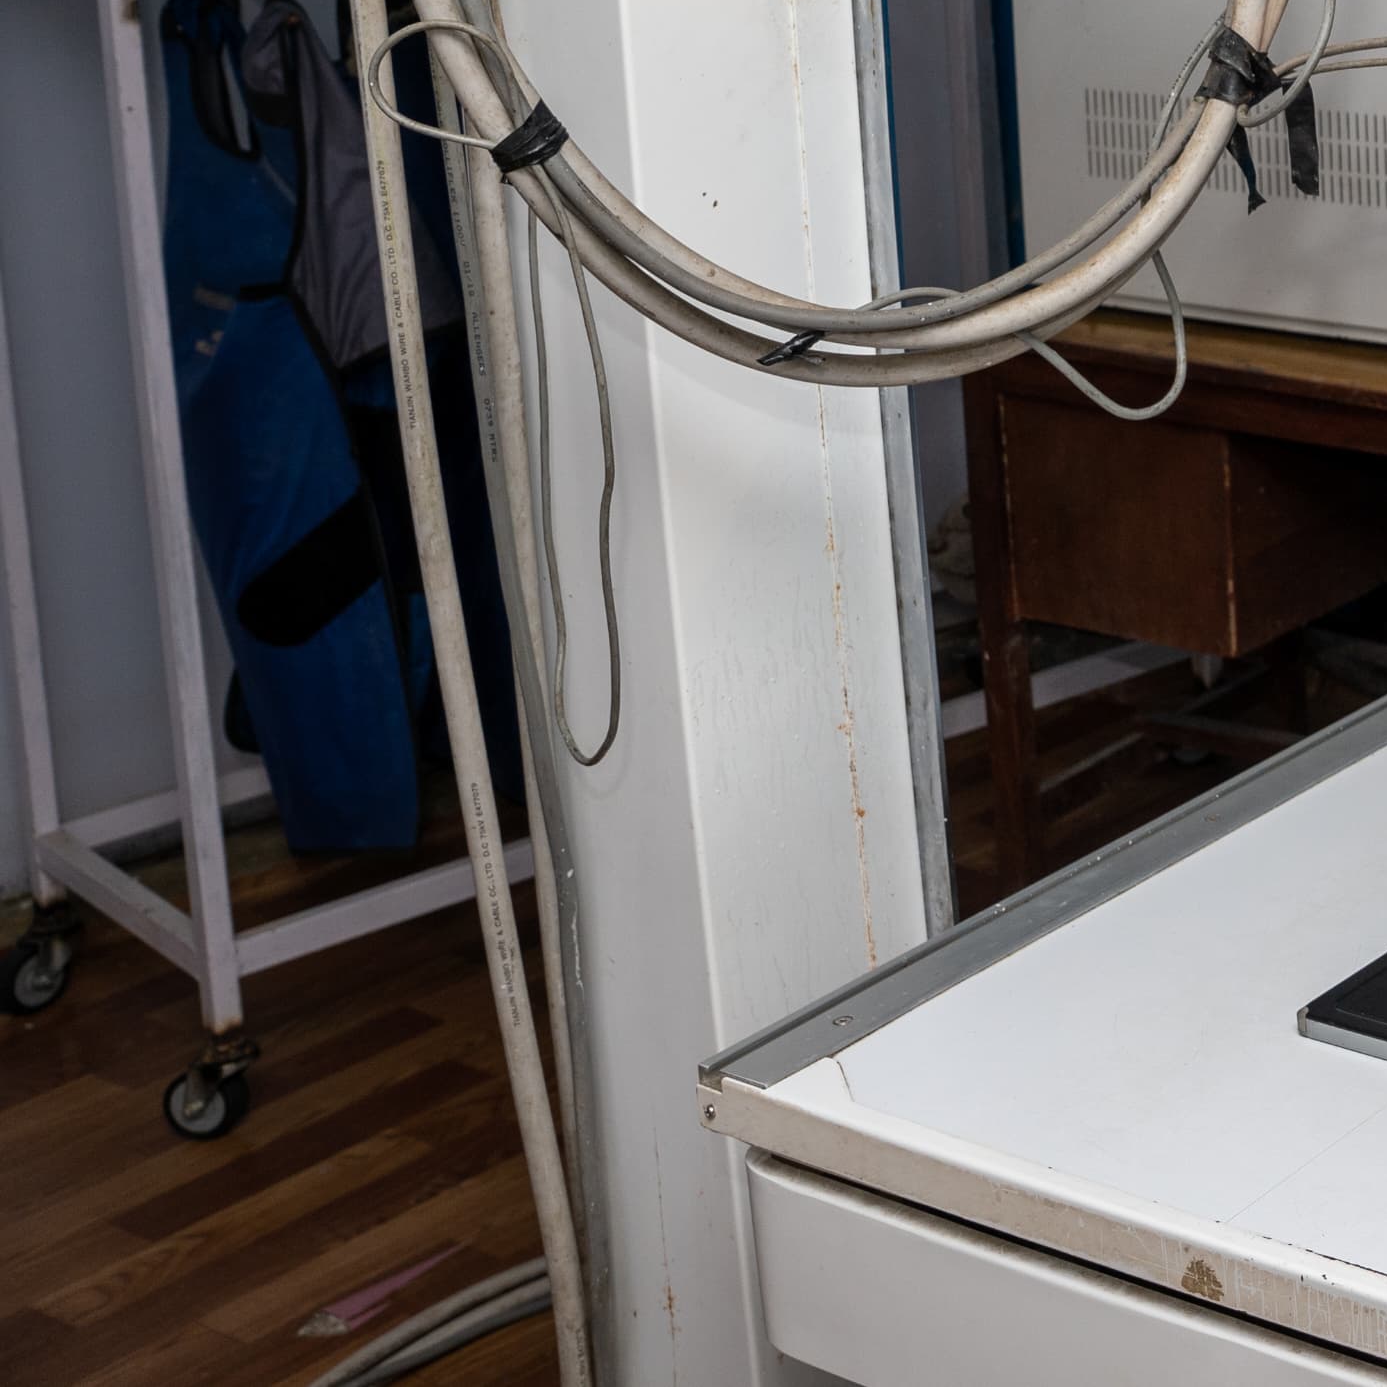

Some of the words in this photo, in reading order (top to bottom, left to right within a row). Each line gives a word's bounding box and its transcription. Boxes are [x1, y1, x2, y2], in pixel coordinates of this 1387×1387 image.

[392, 290, 402, 319] CABLE
[398, 333, 407, 356] WIRE
[472, 312, 487, 376] ALLENGERS
[400, 359, 412, 392] WANBO
[407, 395, 416, 430] TIANJIN
[490, 900, 502, 928] CABLE
[498, 940, 507, 960] WIRE
[502, 963, 514, 994] WANBO
[509, 996, 521, 1028] TIANJIN
